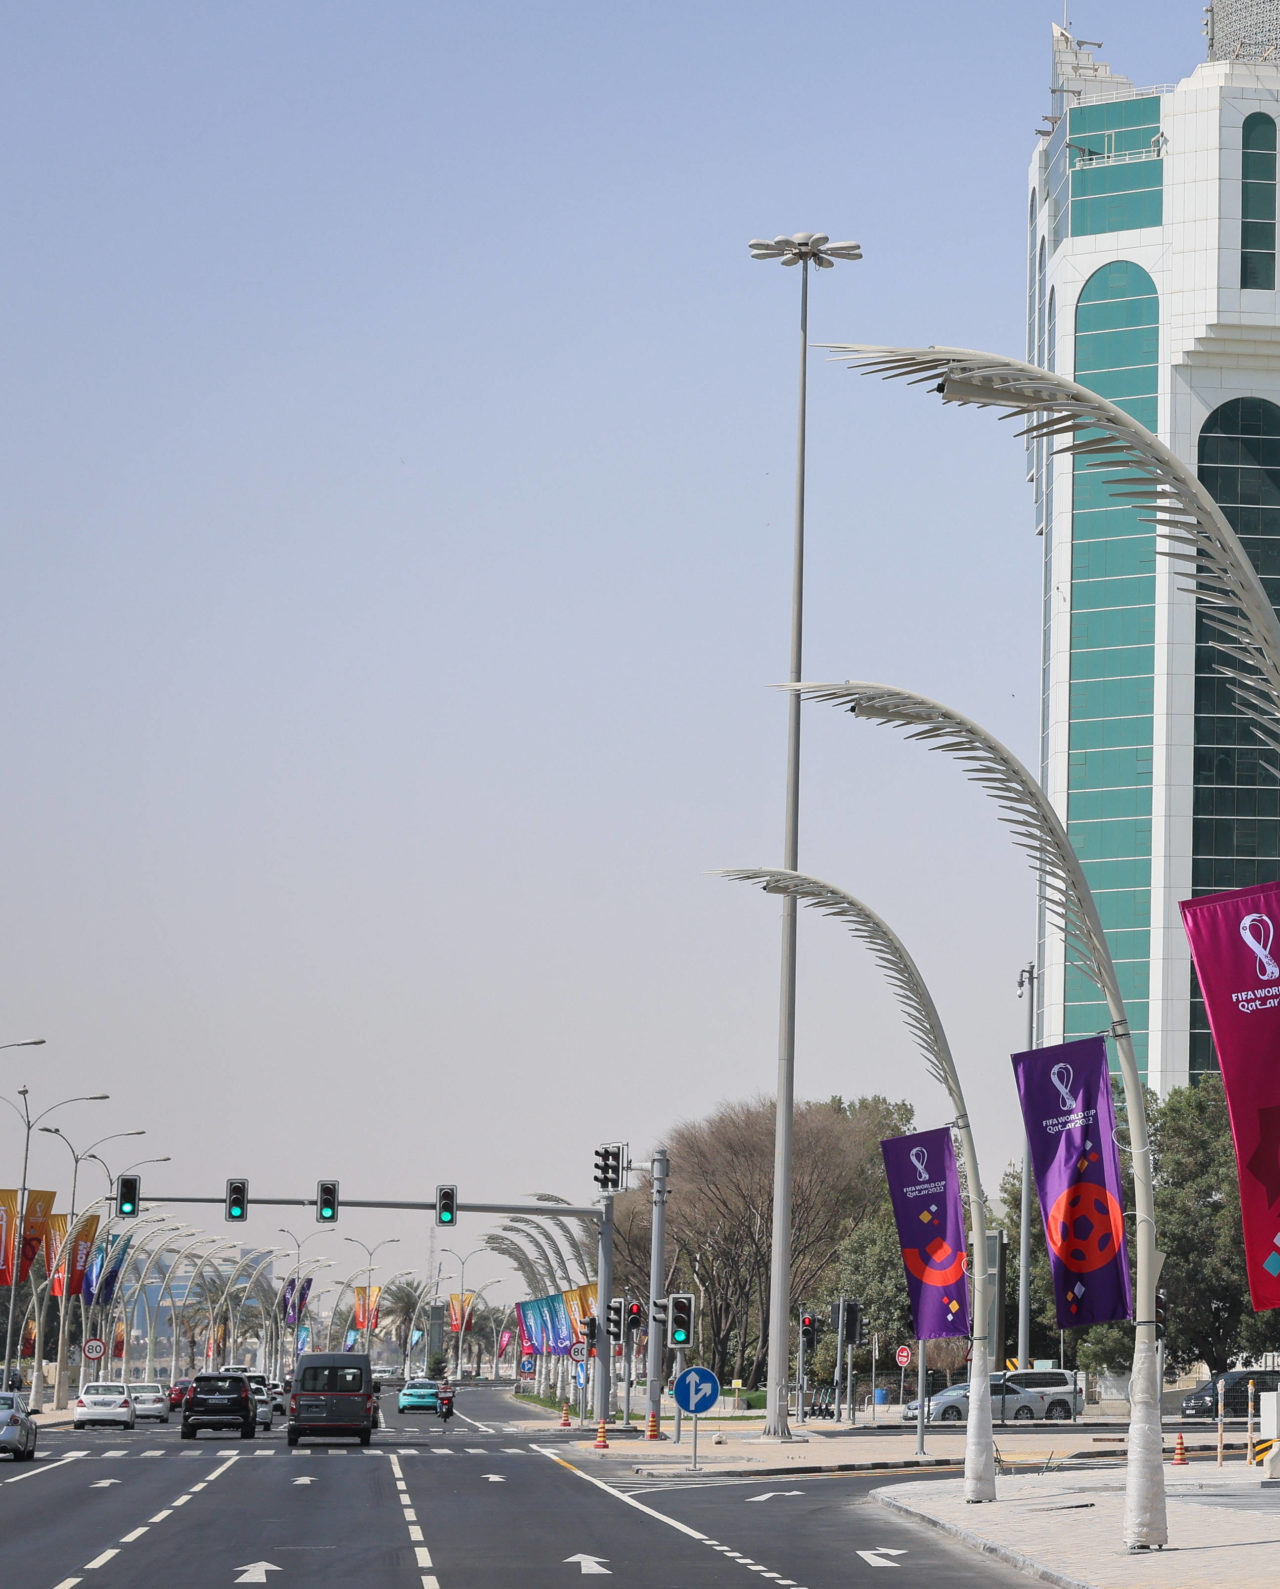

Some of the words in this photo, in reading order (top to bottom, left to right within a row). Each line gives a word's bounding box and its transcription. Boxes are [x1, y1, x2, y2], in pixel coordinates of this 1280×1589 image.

[1231, 990, 1255, 1002] FIFA
[1042, 1118, 1058, 1127] FIFA
[1057, 1111, 1084, 1124] WORLD
[1084, 1109, 1096, 1117] CUP
[87, 1344, 103, 1354] 80
